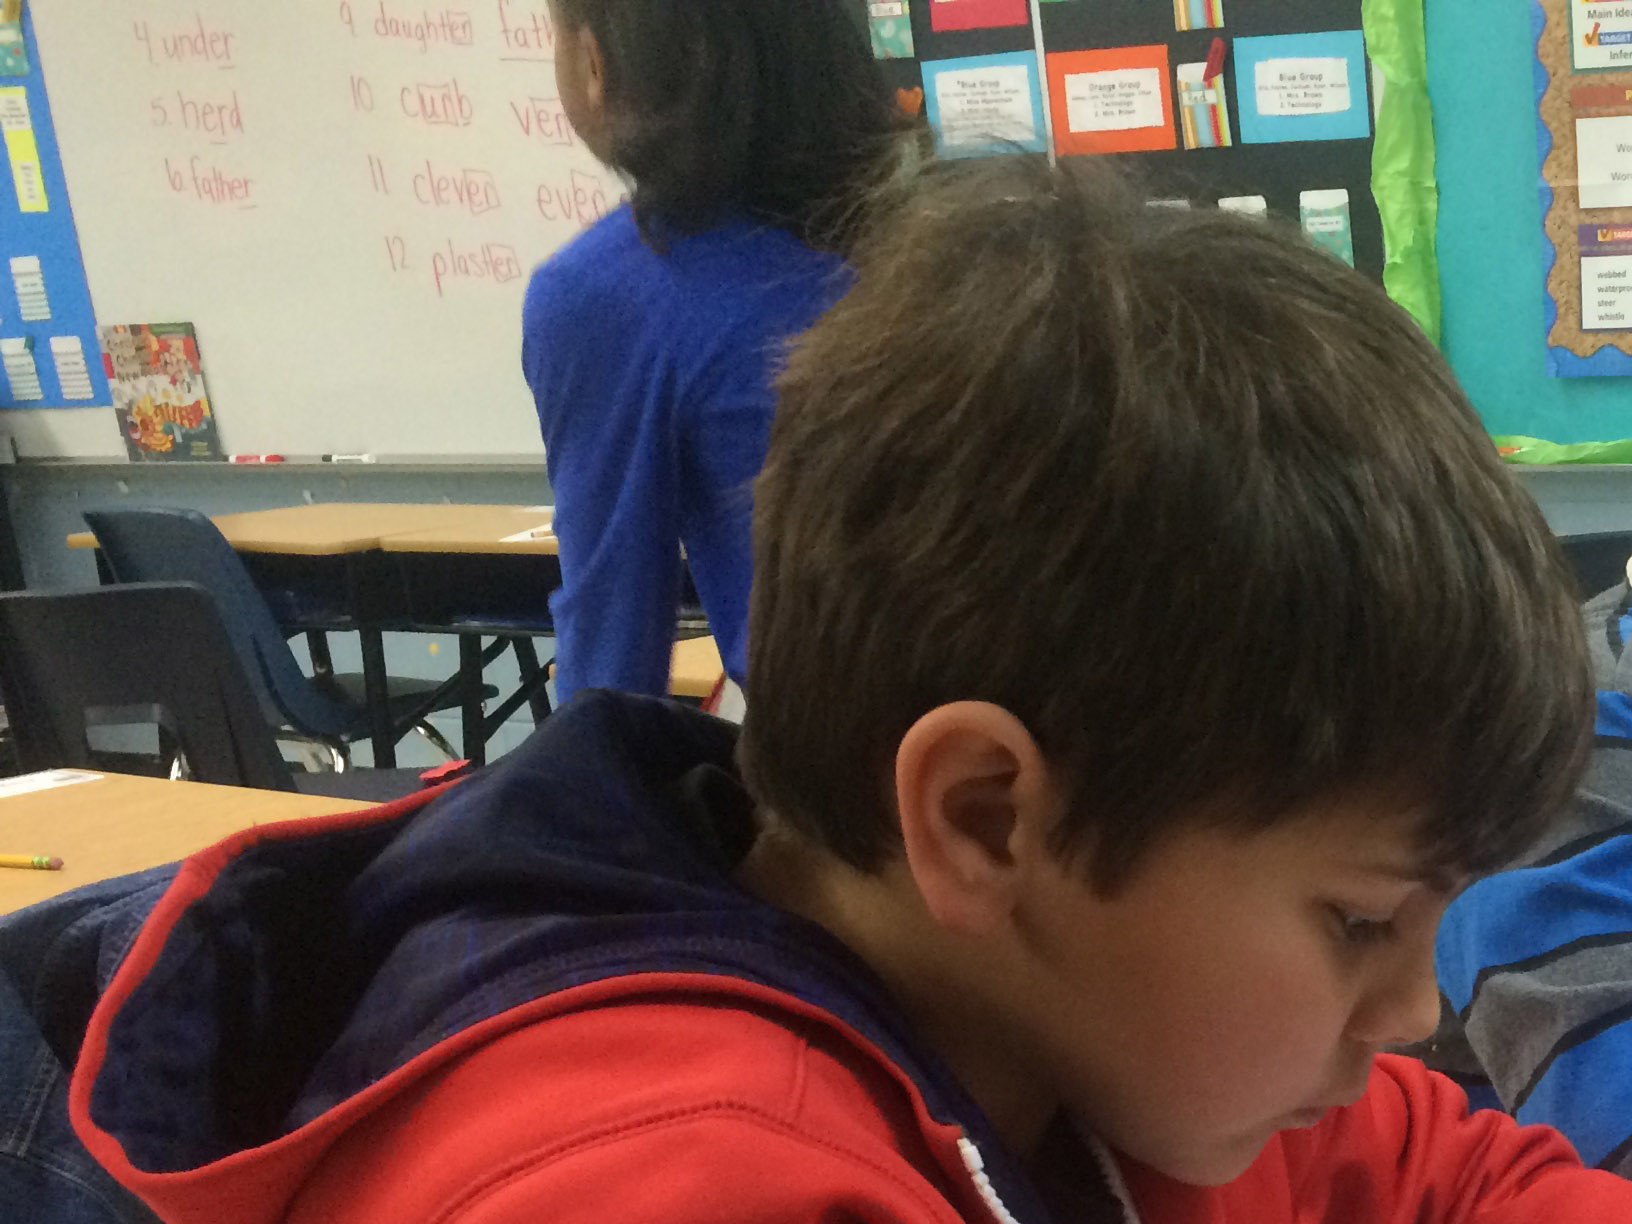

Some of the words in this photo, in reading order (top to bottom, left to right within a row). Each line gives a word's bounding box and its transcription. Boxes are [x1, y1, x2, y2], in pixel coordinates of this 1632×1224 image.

[1587, 8, 1612, 19] Main
[162, 12, 235, 62] under
[177, 90, 244, 136] herd
[190, 155, 255, 204] father
[1597, 299, 1617, 307] steer
[1598, 312, 1625, 321] whistle
